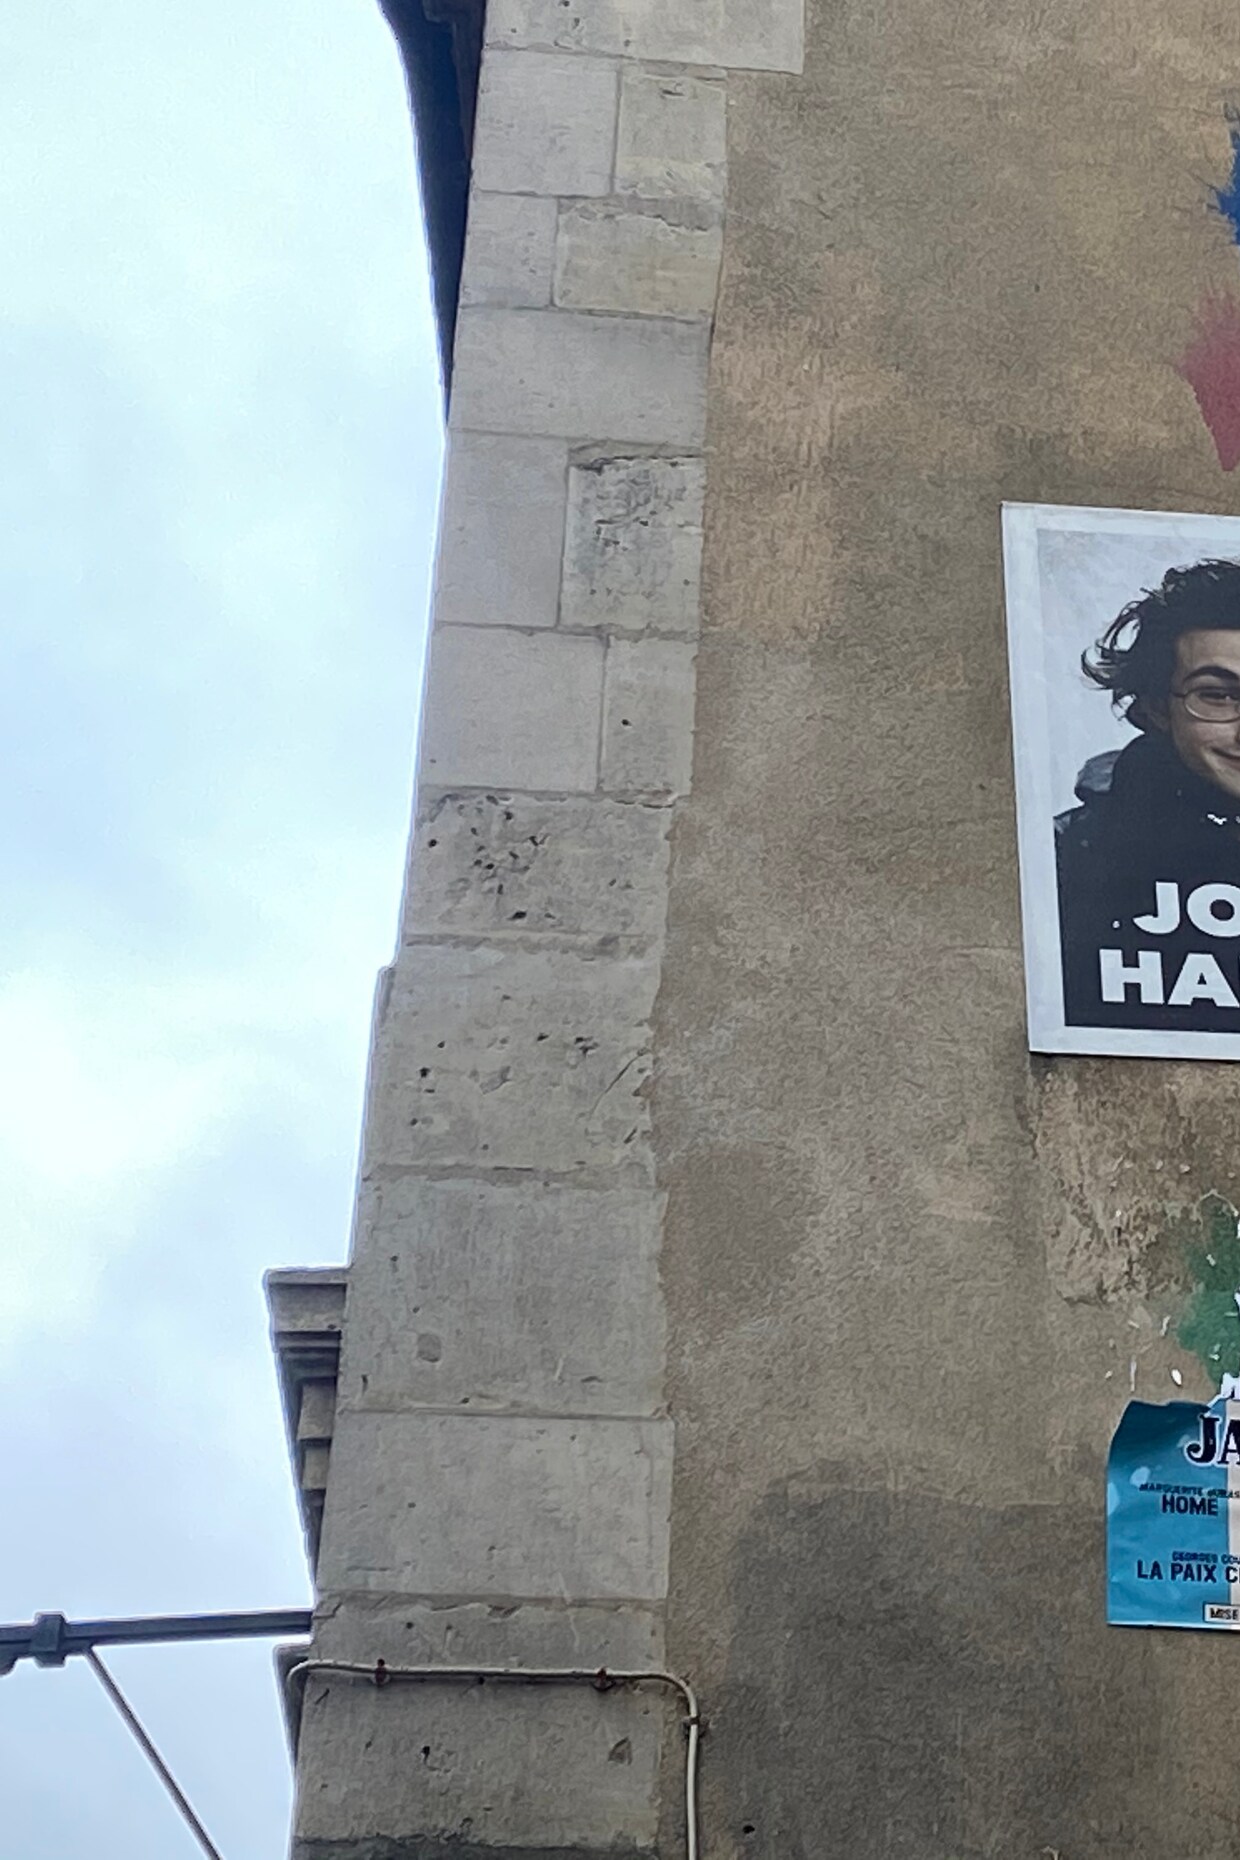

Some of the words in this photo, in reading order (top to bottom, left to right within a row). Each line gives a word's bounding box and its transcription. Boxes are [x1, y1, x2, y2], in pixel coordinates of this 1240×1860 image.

[1161, 1493, 1219, 1516] HOME
[1136, 1559, 1164, 1580] LA
[1170, 1562, 1218, 1583] PAIX
[1209, 1607, 1239, 1621] MISE
